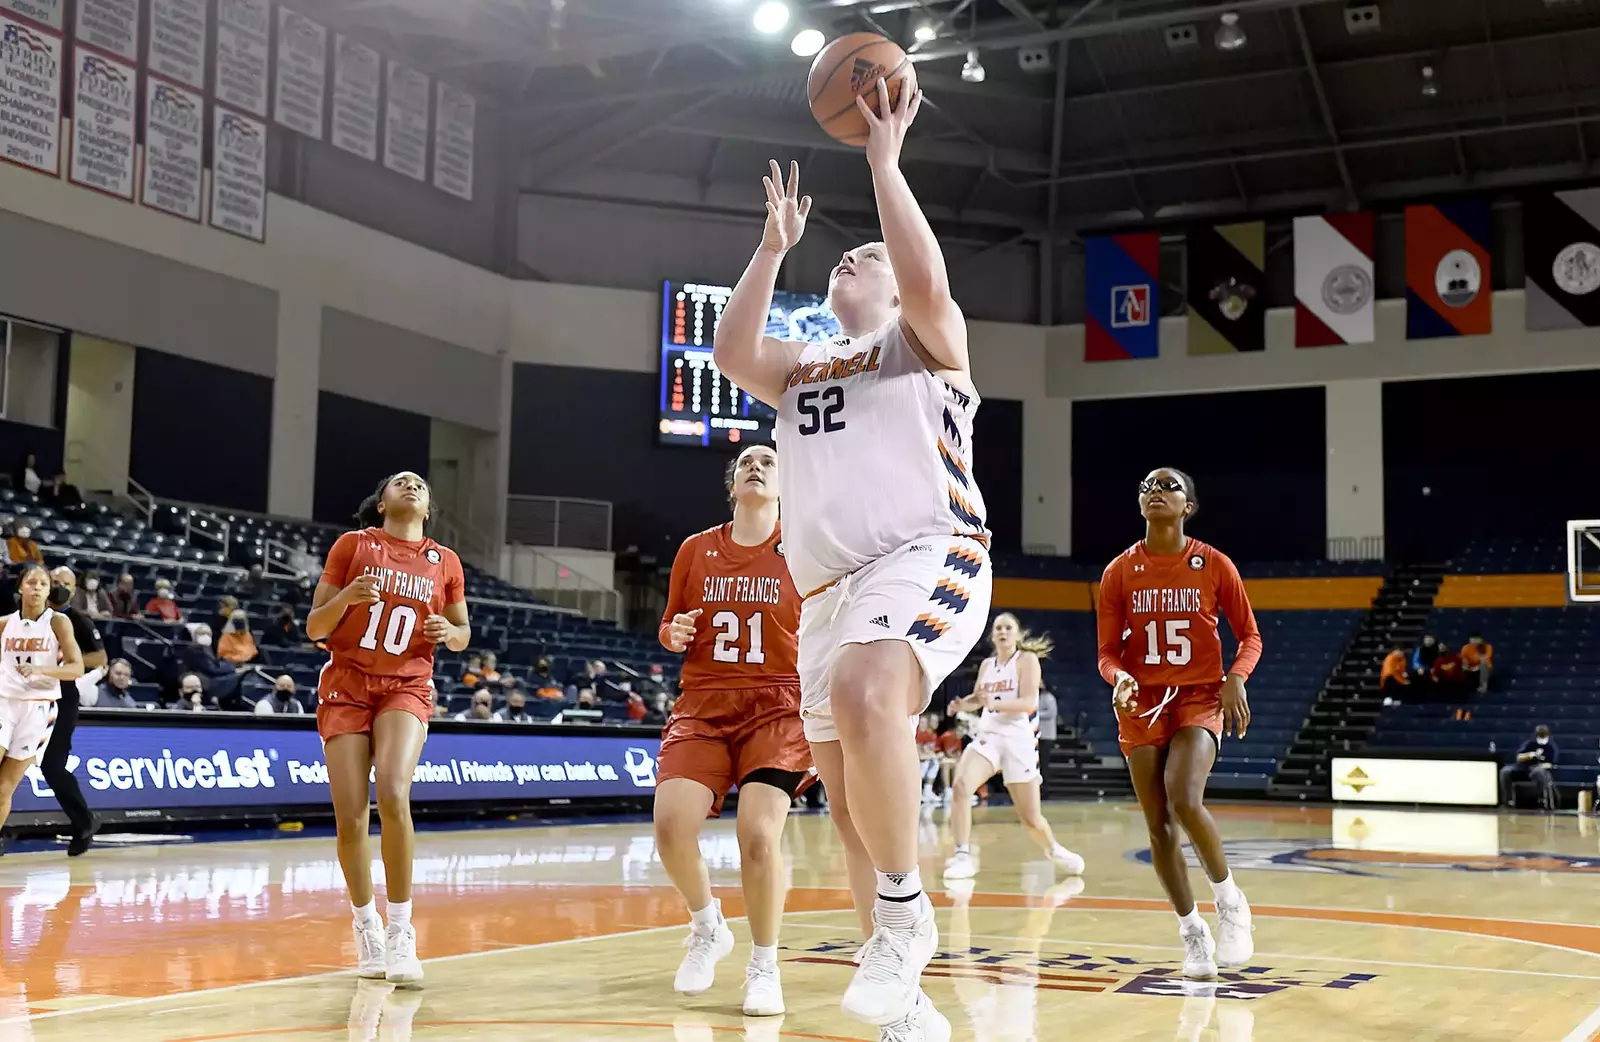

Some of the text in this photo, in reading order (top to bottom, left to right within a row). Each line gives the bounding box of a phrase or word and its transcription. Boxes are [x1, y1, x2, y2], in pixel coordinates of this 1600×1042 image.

[786, 346, 881, 387] UCKNELL
[797, 386, 846, 436] 52
[393, 571, 435, 604] FRANCIS
[702, 576, 781, 604] SAINT FRANCIS
[1132, 588, 1201, 613] SAINT FRANCIS
[359, 600, 417, 656] 10
[712, 610, 765, 664] 21
[1144, 619, 1192, 666] 15
[86, 748, 276, 790] service1st
[460, 760, 514, 782] Friends
[513, 764, 541, 785] you
[540, 764, 566, 782] can
[563, 760, 598, 782] bank
